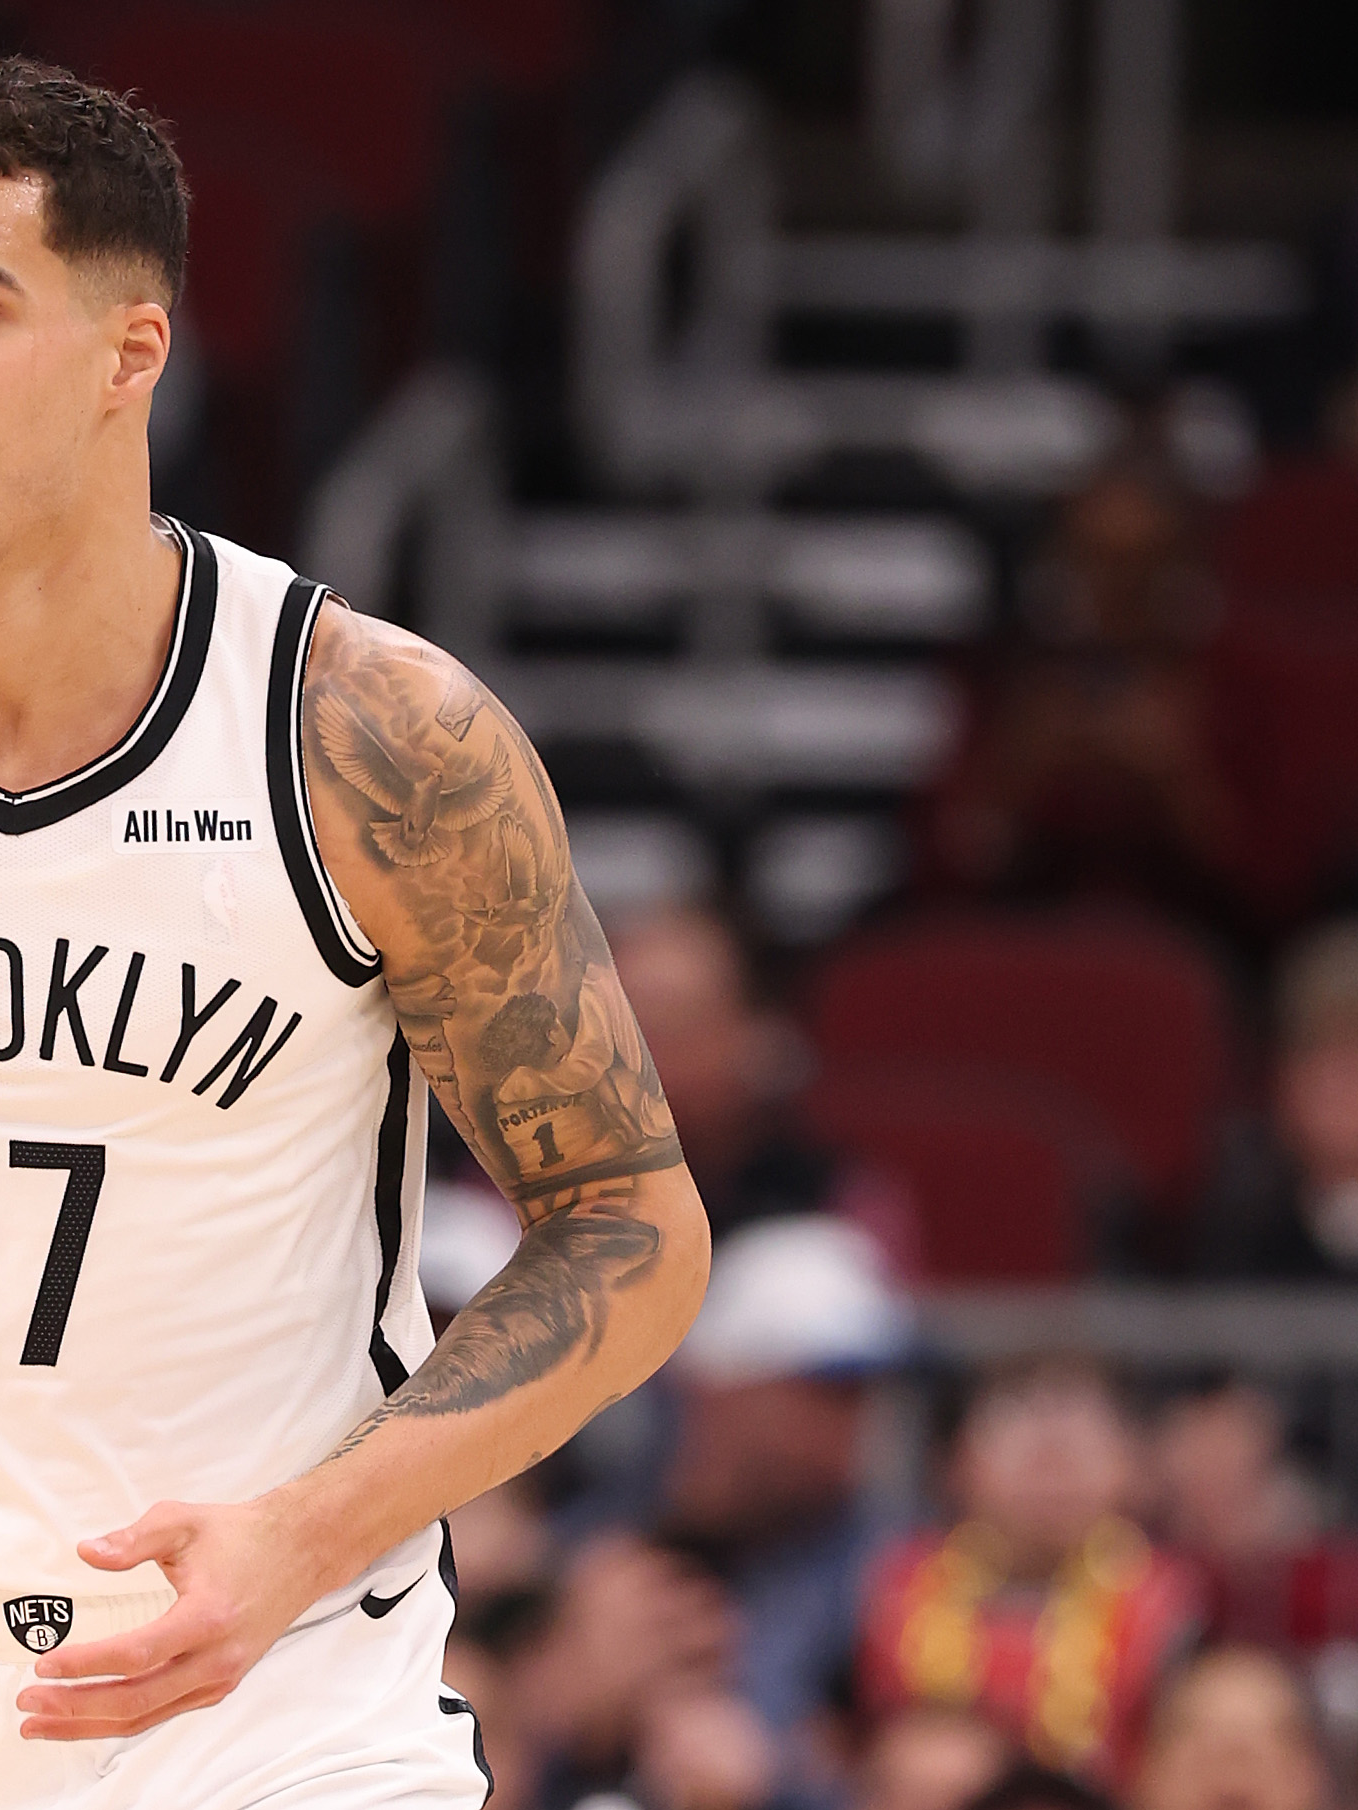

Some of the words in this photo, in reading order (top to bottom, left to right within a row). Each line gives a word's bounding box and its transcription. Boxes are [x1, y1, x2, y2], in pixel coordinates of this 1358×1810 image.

[123, 809, 158, 843] All
[166, 809, 190, 842] In
[194, 809, 252, 842] Won
[532, 1121, 564, 1169] 1
[9, 1599, 70, 1628] NETS
[36, 1628, 48, 1647] B
